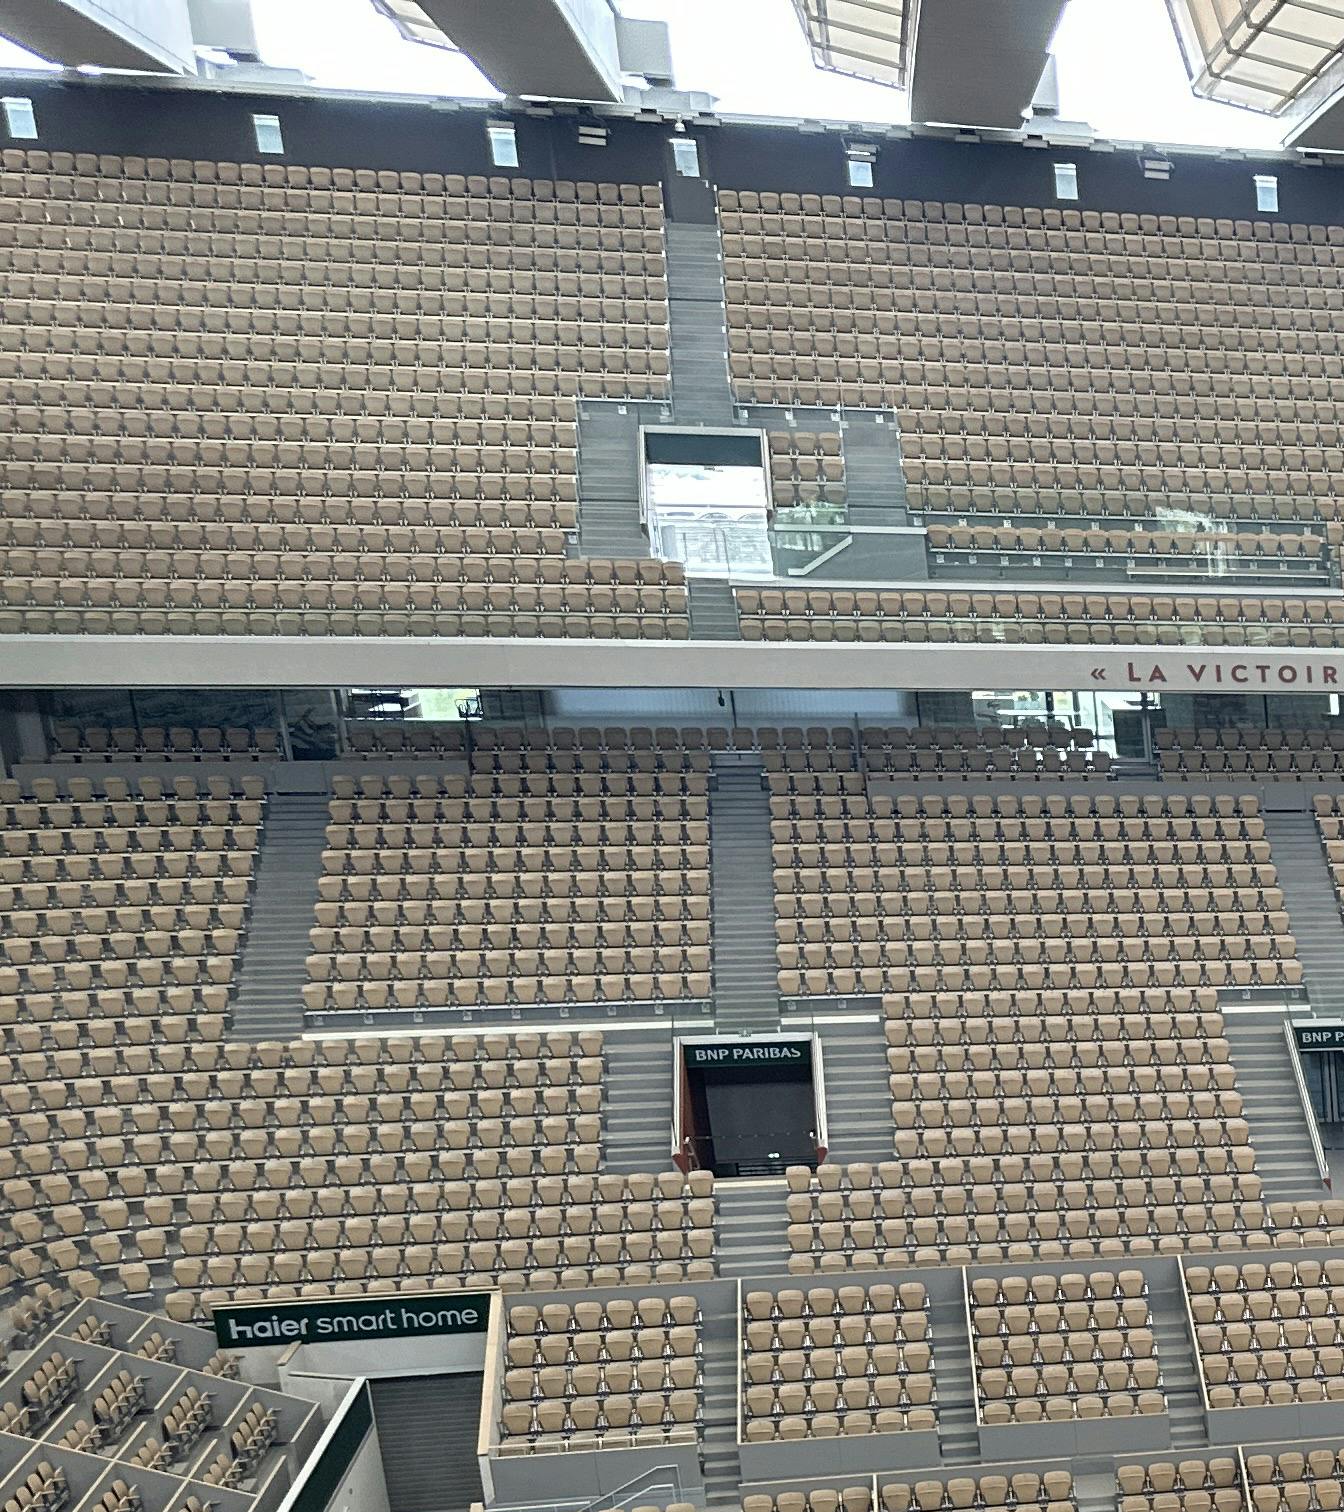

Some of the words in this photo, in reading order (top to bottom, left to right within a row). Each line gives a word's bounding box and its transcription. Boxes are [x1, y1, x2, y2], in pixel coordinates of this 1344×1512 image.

[1127, 662, 1168, 684] LA
[1302, 1031, 1331, 1043] BNP
[695, 1048, 729, 1061] BNP
[733, 1046, 801, 1060] PARIBAS
[229, 1314, 309, 1340] haier
[316, 1309, 397, 1334] smart
[400, 1307, 479, 1329] home
